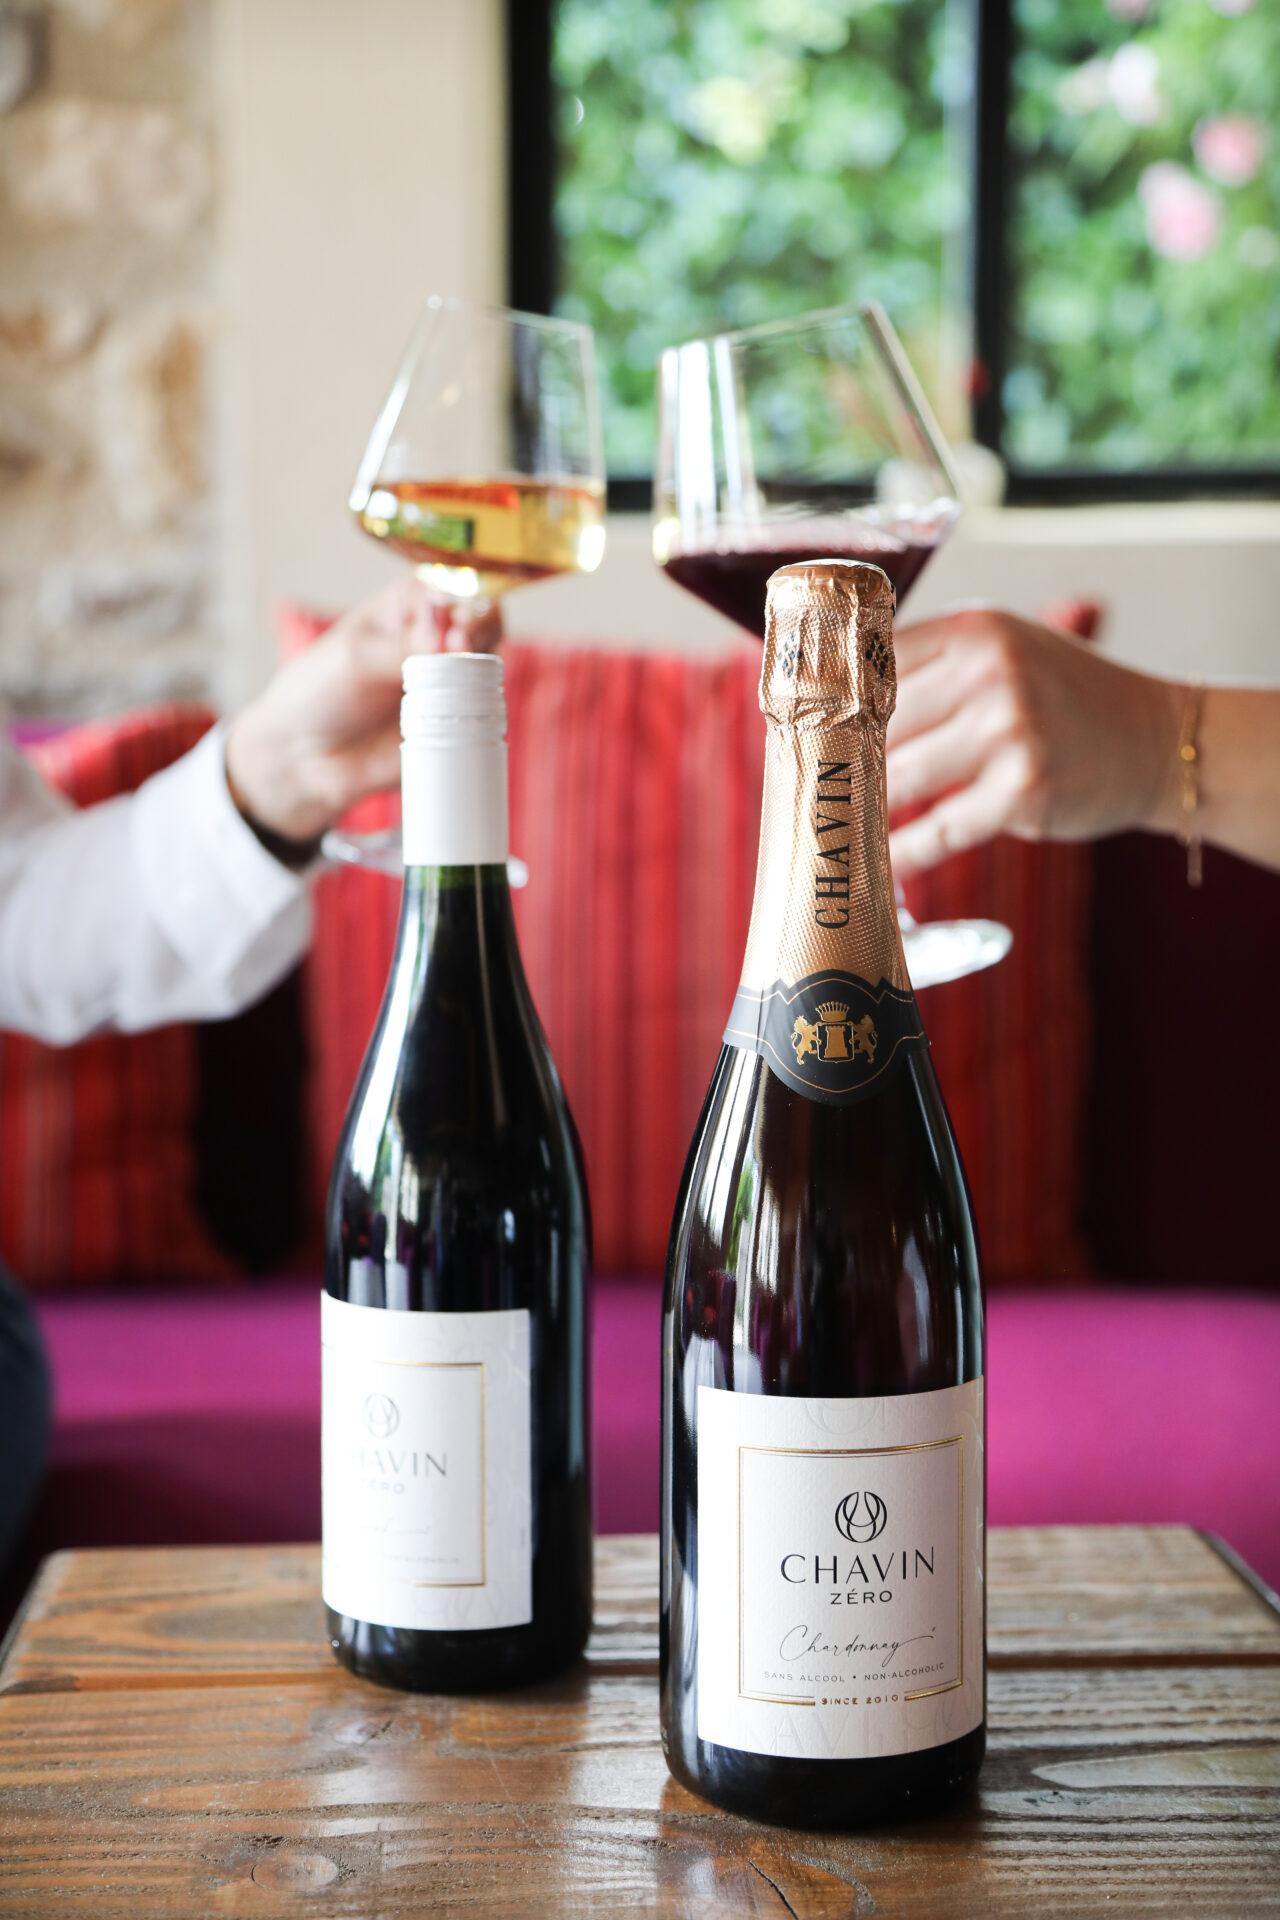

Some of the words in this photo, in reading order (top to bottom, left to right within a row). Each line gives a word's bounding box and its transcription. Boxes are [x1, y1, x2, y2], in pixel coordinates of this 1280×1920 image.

[815, 759, 852, 929] CHAVIN
[780, 1546, 934, 1584] CHAVIN
[830, 1588, 892, 1605] ZÉRO
[780, 1624, 936, 1668] Chardonnay
[764, 1671, 793, 1681] SANS
[800, 1674, 845, 1682] ALCOOL
[822, 1697, 858, 1705] SINCE
[866, 1695, 899, 1704] 2010
